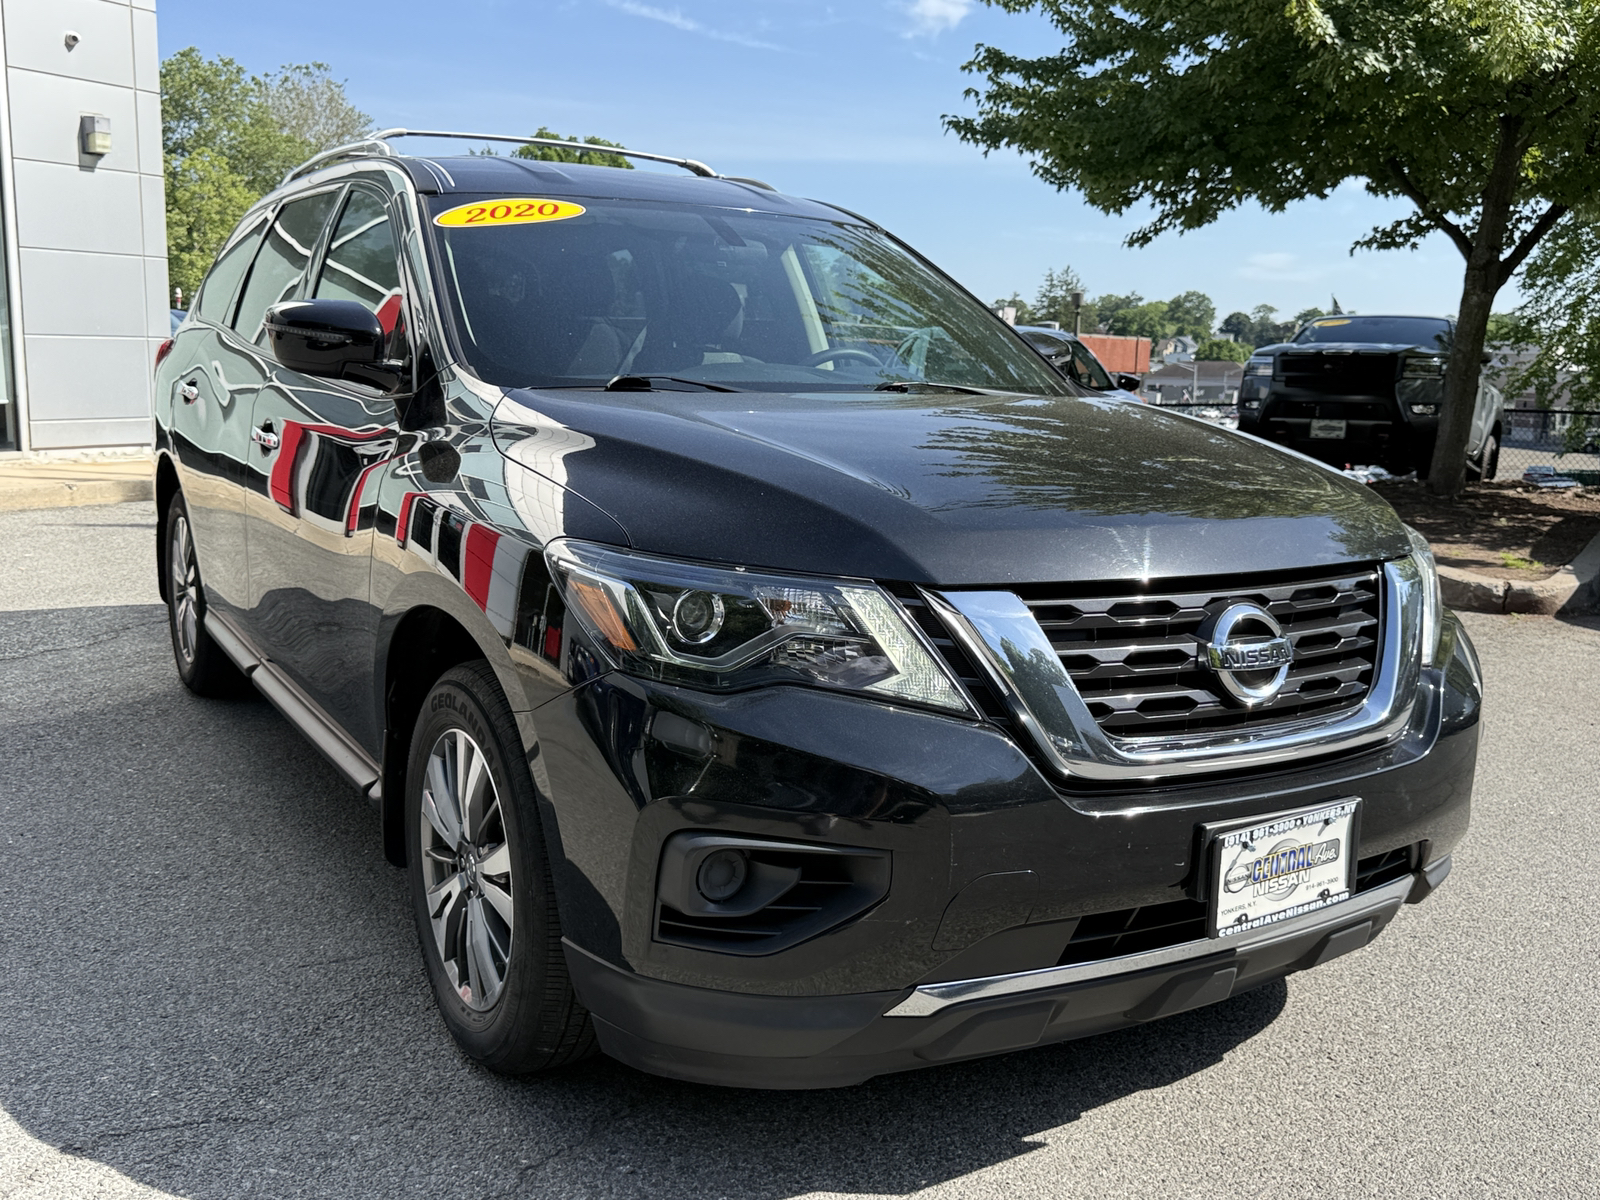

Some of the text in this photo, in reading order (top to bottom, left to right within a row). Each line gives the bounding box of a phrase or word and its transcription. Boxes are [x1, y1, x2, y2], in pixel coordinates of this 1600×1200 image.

[465, 203, 559, 223] 2020
[1223, 647, 1292, 669] NISSAN
[1251, 843, 1337, 883] CENTRAL Ave.
[1252, 868, 1312, 898] NISSAN
